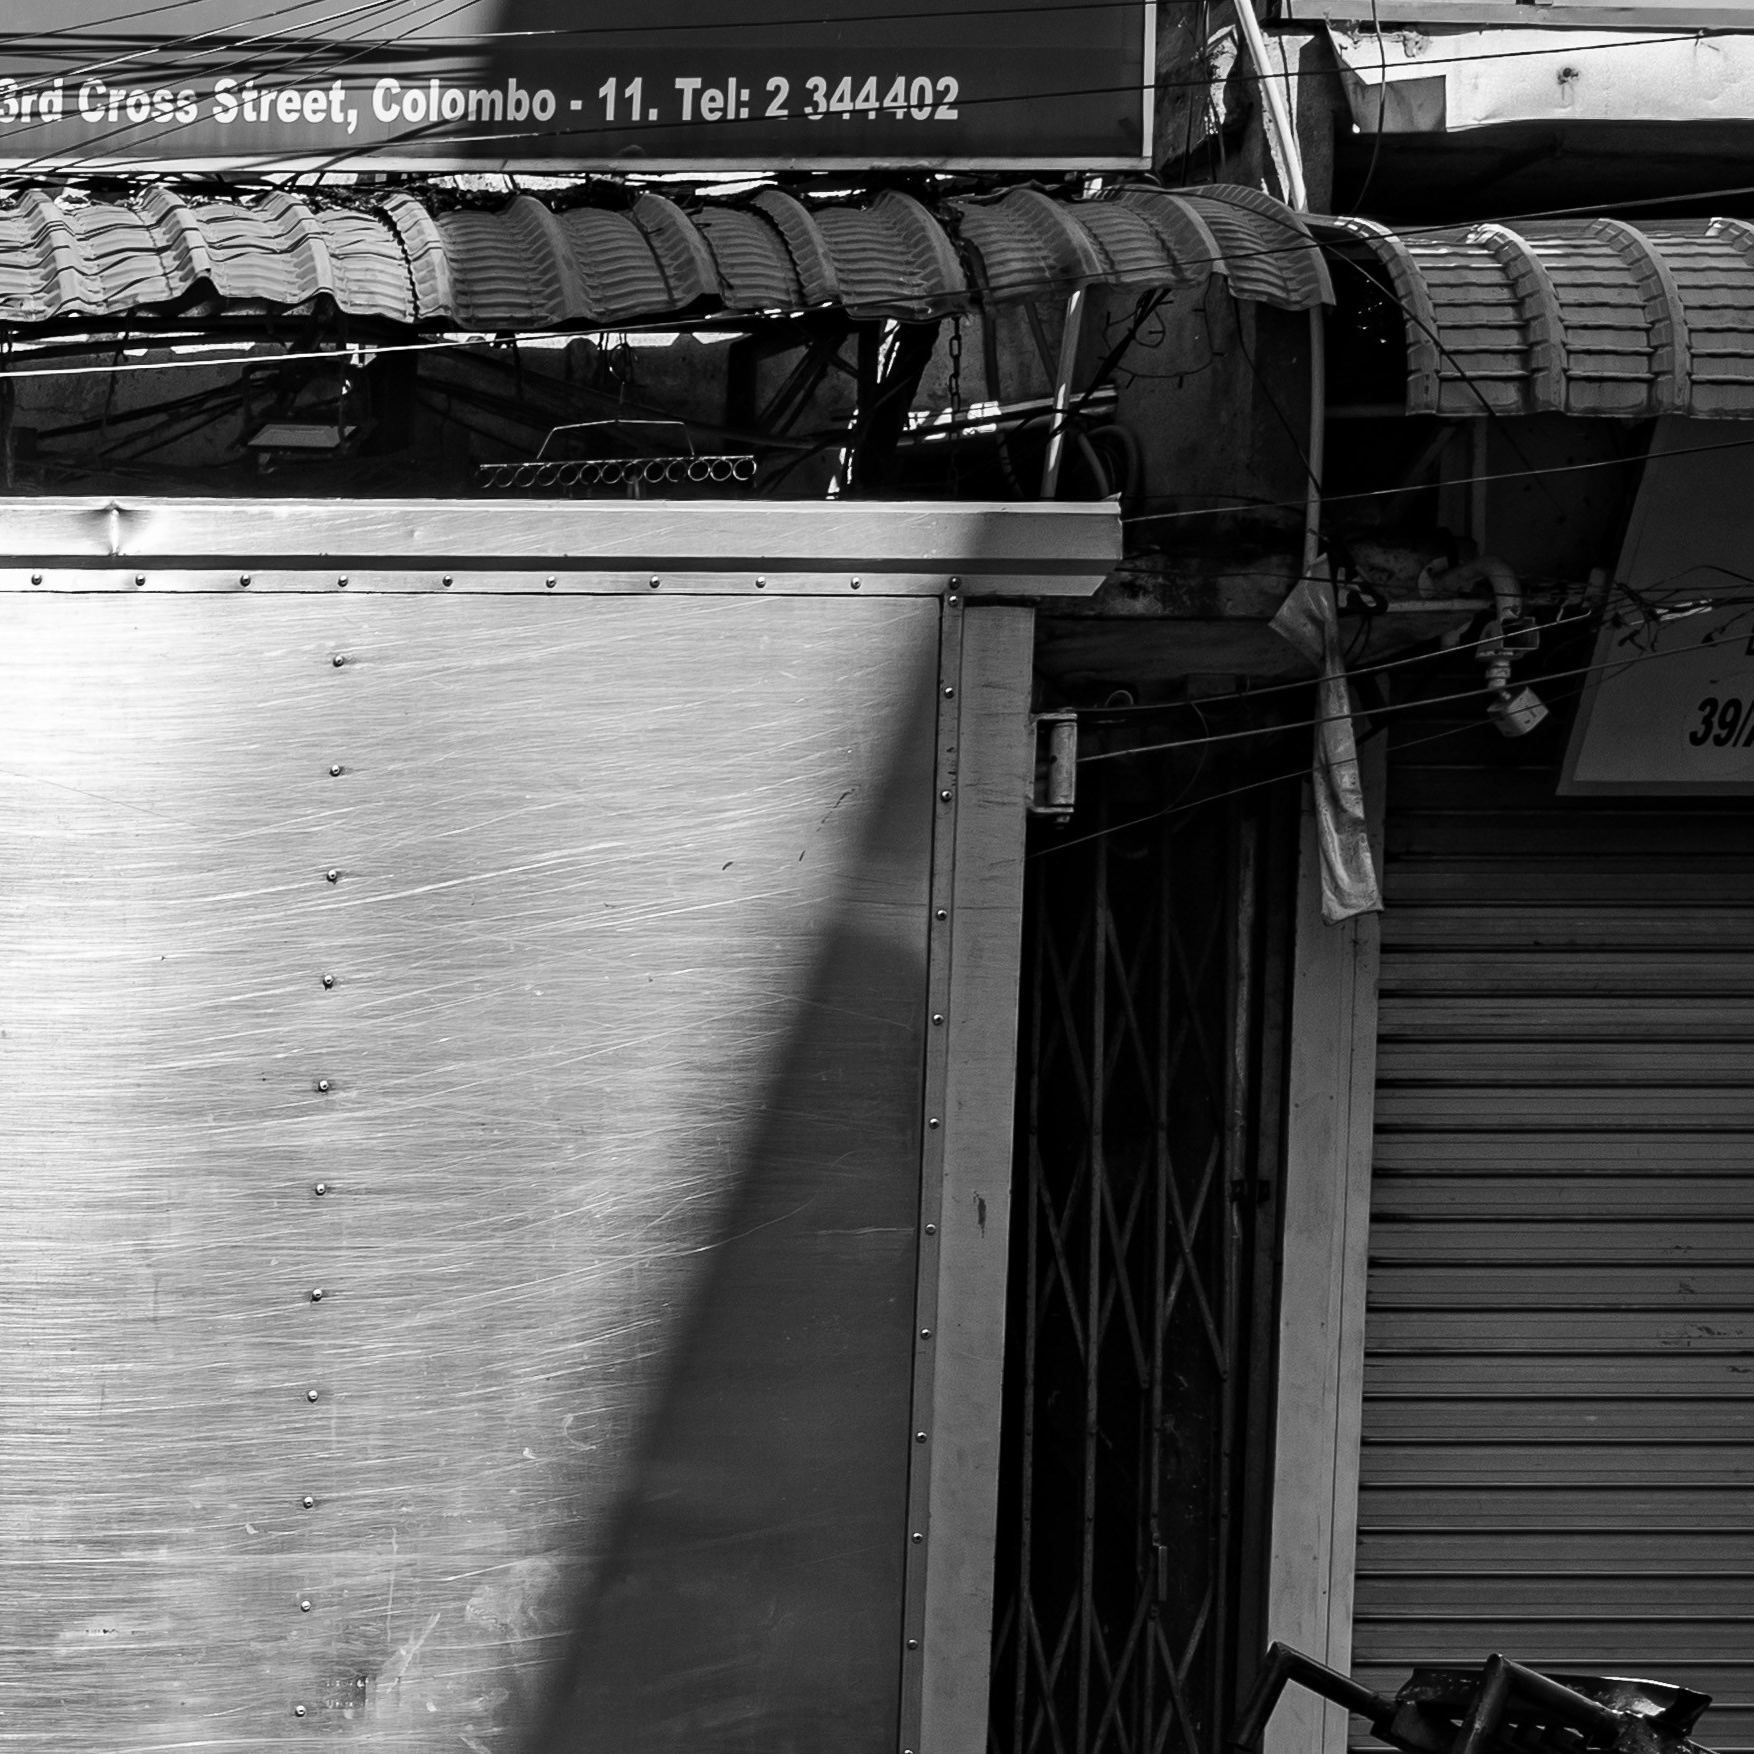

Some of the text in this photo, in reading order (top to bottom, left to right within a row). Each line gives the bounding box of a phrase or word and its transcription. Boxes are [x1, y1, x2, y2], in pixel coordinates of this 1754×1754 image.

[77, 77, 198, 123] Cross
[212, 78, 359, 135] Street,
[372, 78, 557, 123] Colombo
[598, 78, 659, 122] 11.
[676, 77, 751, 122] Tel:
[766, 77, 791, 121] 2
[805, 76, 960, 122] 344402
